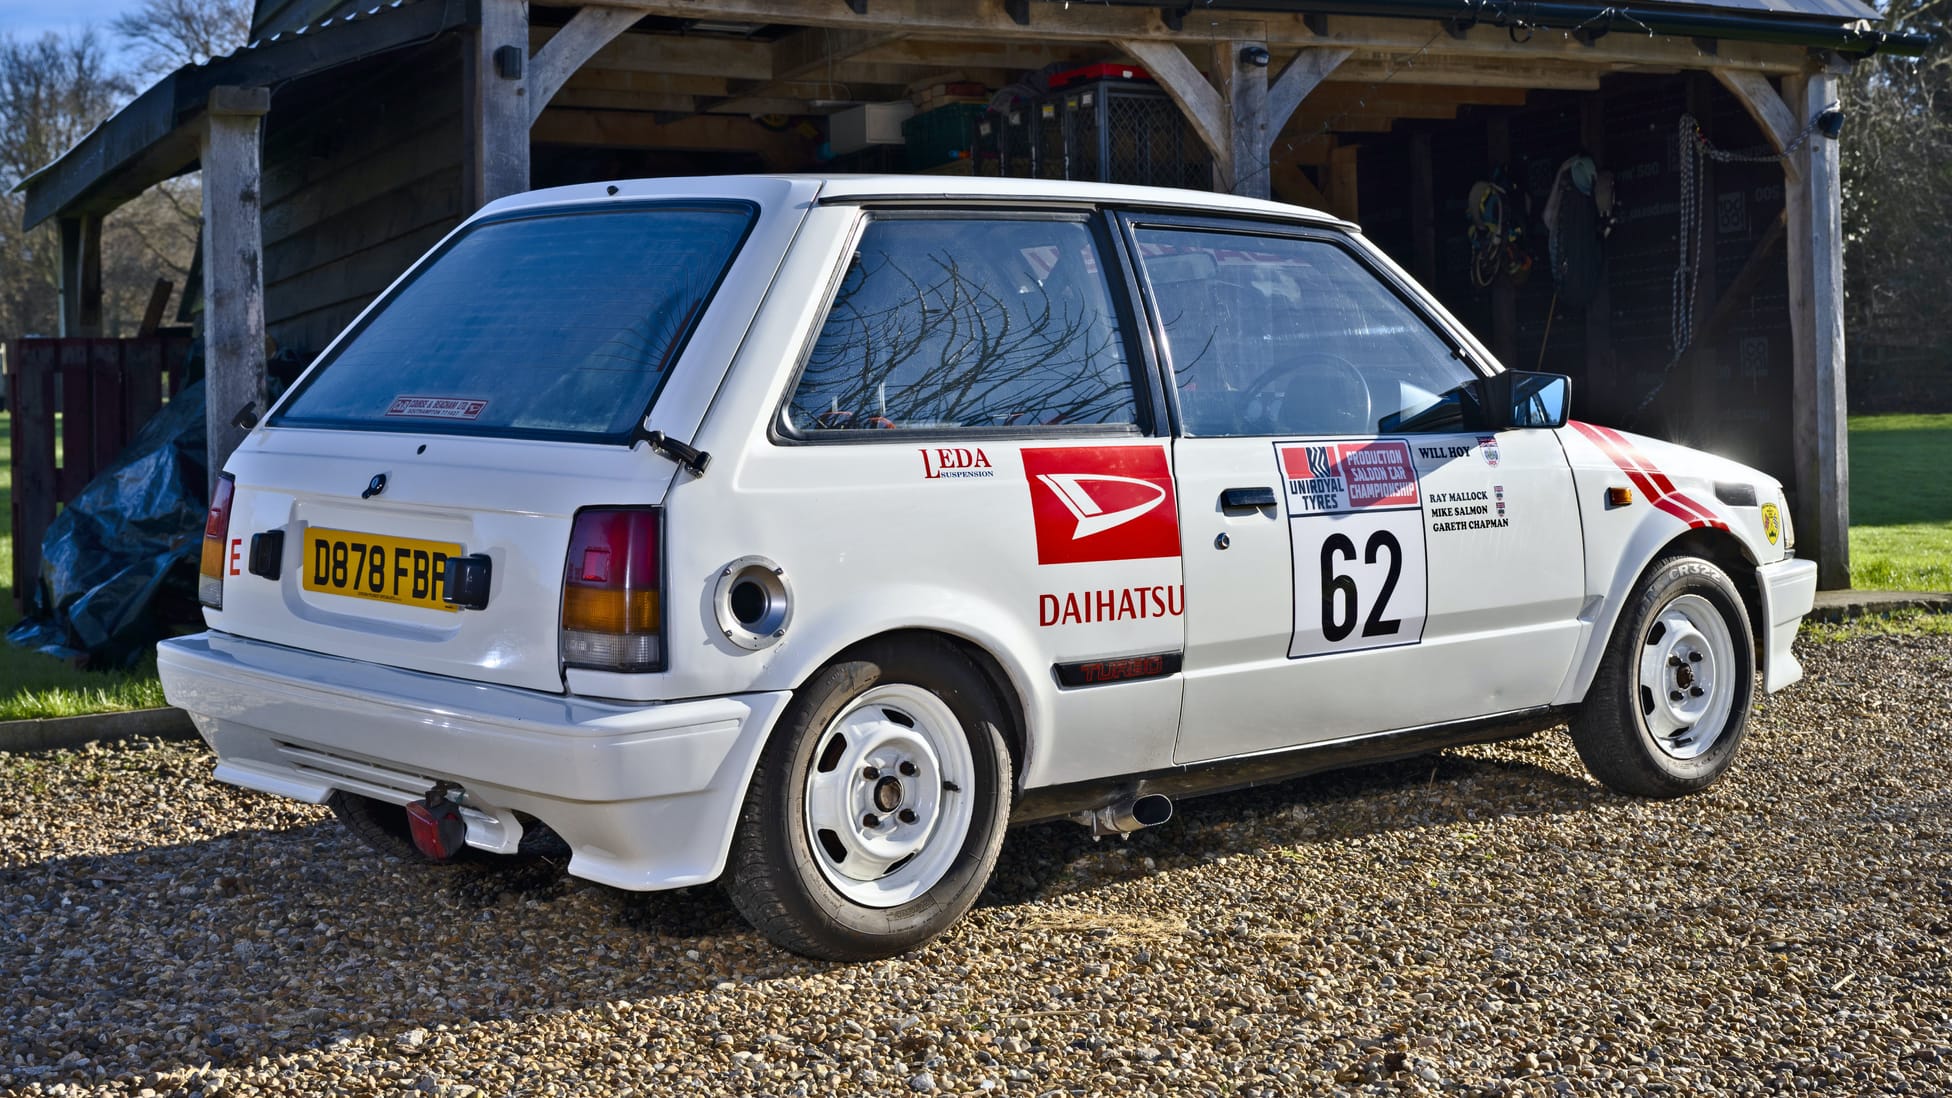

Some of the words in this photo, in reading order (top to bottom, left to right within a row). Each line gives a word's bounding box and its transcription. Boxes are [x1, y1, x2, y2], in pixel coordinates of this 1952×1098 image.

[1346, 449, 1403, 466] PRODUCTION
[1419, 447, 1447, 459] WILL
[1448, 446, 1470, 458] HOY
[918, 448, 992, 478] LEDA
[1351, 467, 1388, 481] SALOON
[1388, 466, 1407, 479] CAR
[1289, 478, 1344, 494] UNIROYAL
[1350, 482, 1415, 499] CHAMPIONSHIP
[1302, 494, 1338, 510] TYRES
[1429, 493, 1447, 503] RAY
[1449, 491, 1488, 502] MALLOCK
[1431, 508, 1453, 517] MIKE
[1455, 505, 1488, 516] SALMON
[1433, 521, 1467, 532] GARETH
[1469, 518, 1509, 529] CHAPMAN
[230, 539, 242, 576] E
[314, 539, 386, 593] D878
[1669, 564, 1721, 582] CR322
[1320, 530, 1402, 642] 62
[1040, 585, 1184, 626] DAIHATSU
[1081, 656, 1163, 682] TURBO
